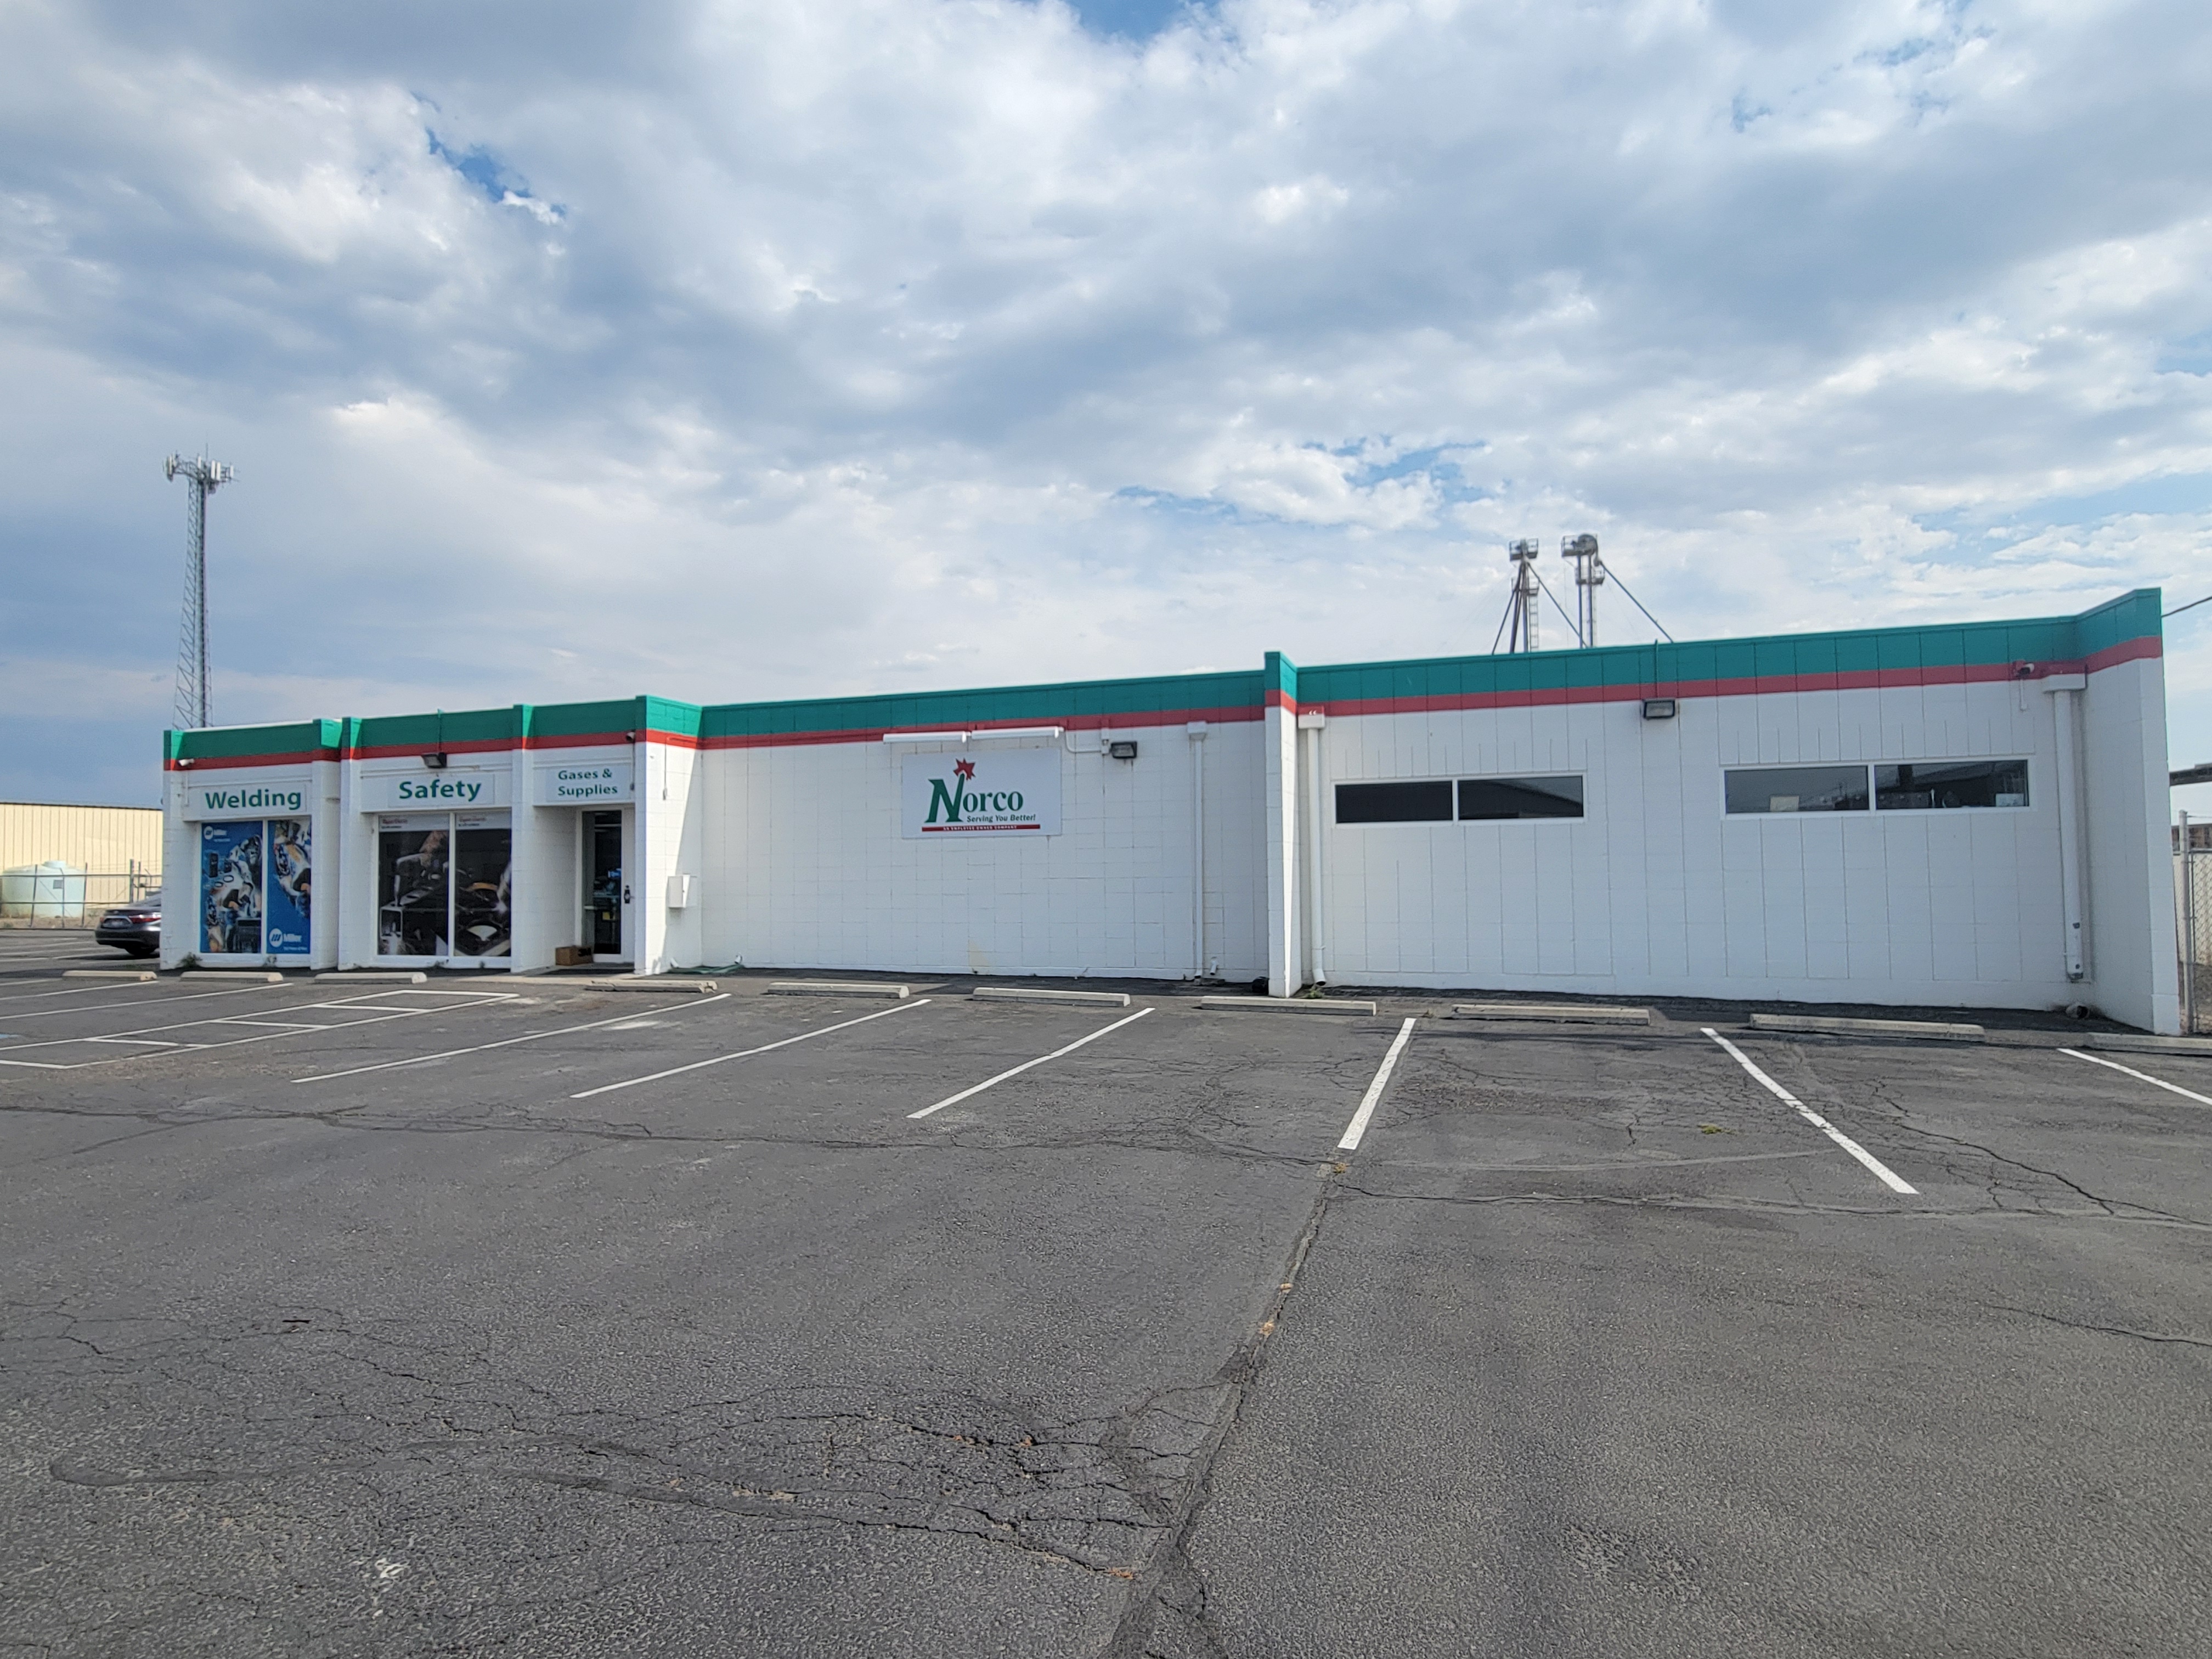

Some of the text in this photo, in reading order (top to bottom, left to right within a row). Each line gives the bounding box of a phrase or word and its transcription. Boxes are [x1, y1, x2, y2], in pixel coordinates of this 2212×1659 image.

[558, 768, 612, 780] Gases &
[205, 788, 301, 810] Welding
[399, 779, 482, 802] Safety
[558, 784, 618, 797] Supplies
[924, 773, 1023, 823] Norco
